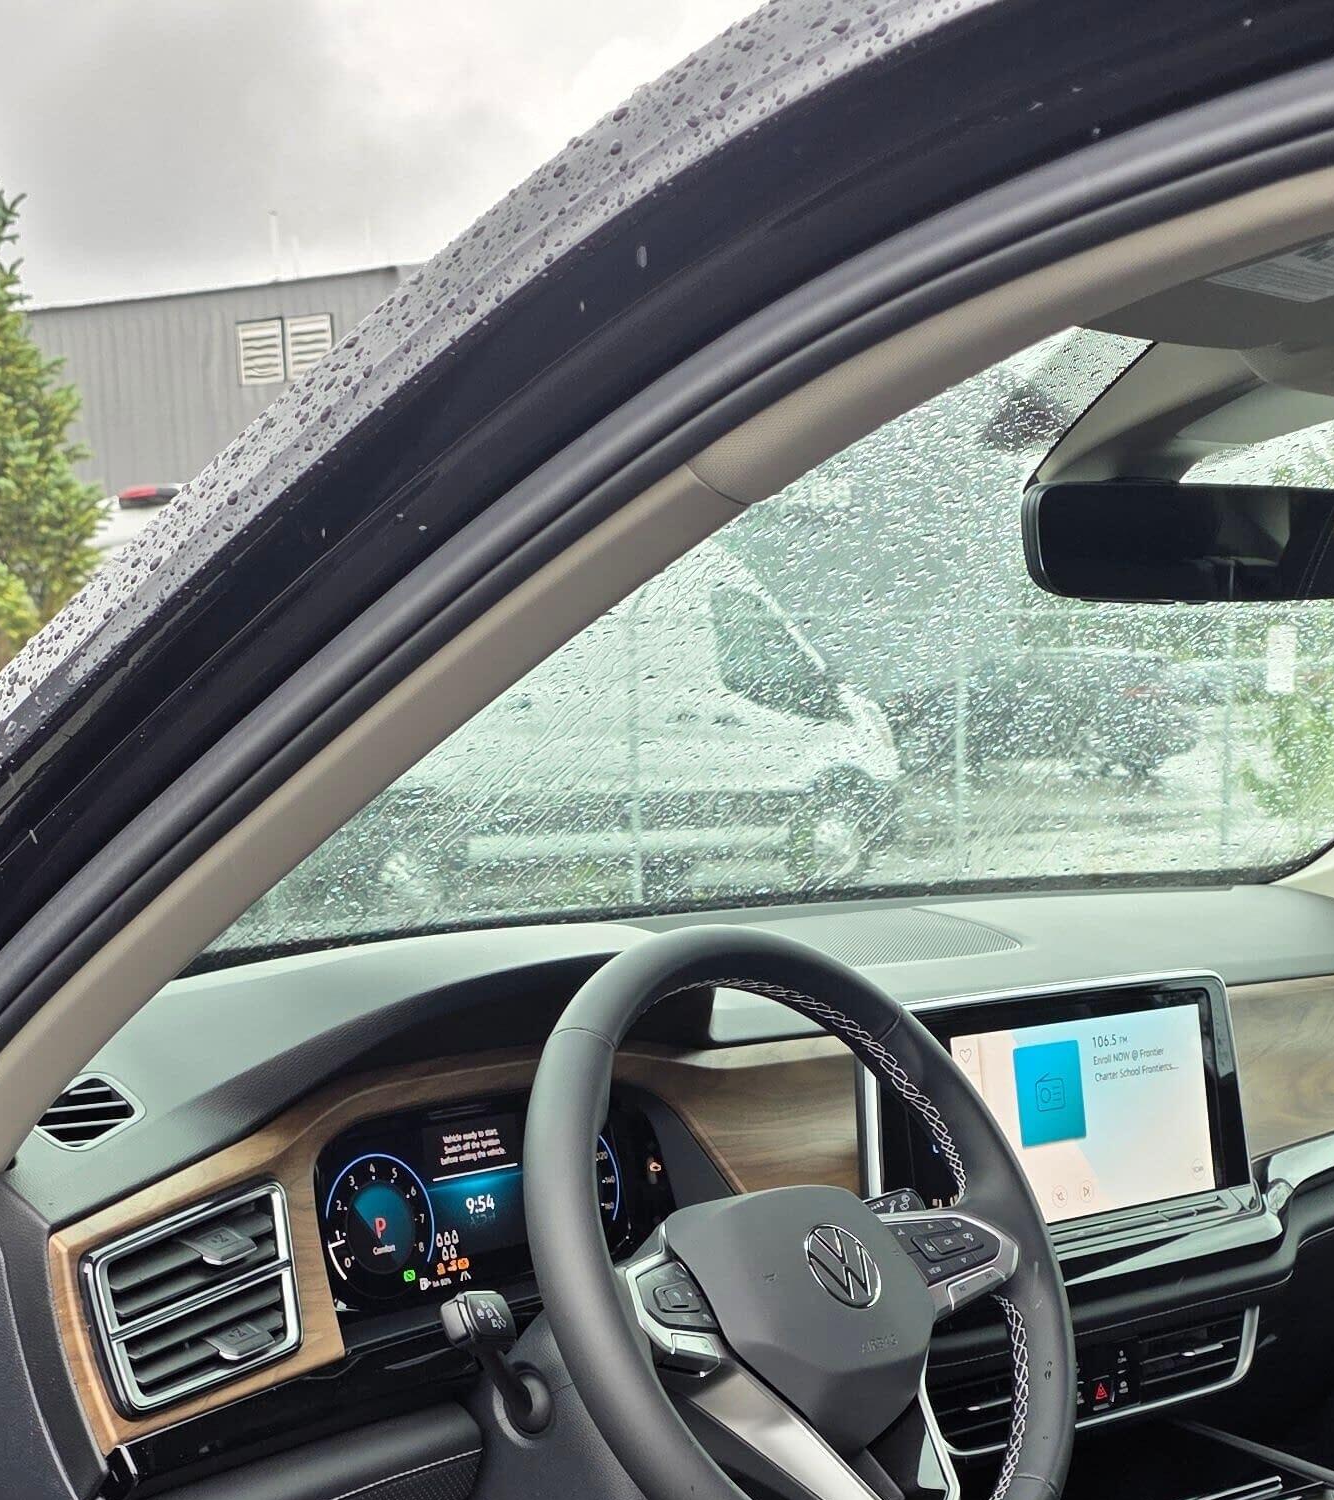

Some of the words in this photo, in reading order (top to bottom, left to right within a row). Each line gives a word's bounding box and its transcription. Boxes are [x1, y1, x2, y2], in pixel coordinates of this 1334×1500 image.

[1092, 1034, 1116, 1048] 106.5
[1093, 1055, 1111, 1066] Enroll
[1112, 1051, 1130, 1062] NOW
[1140, 1047, 1164, 1058] Frontier
[1119, 1065, 1140, 1078] School
[348, 1175, 355, 1186] 3
[336, 1200, 342, 1211] 2
[465, 1193, 495, 1214] 9:54
[375, 1217, 386, 1239] P
